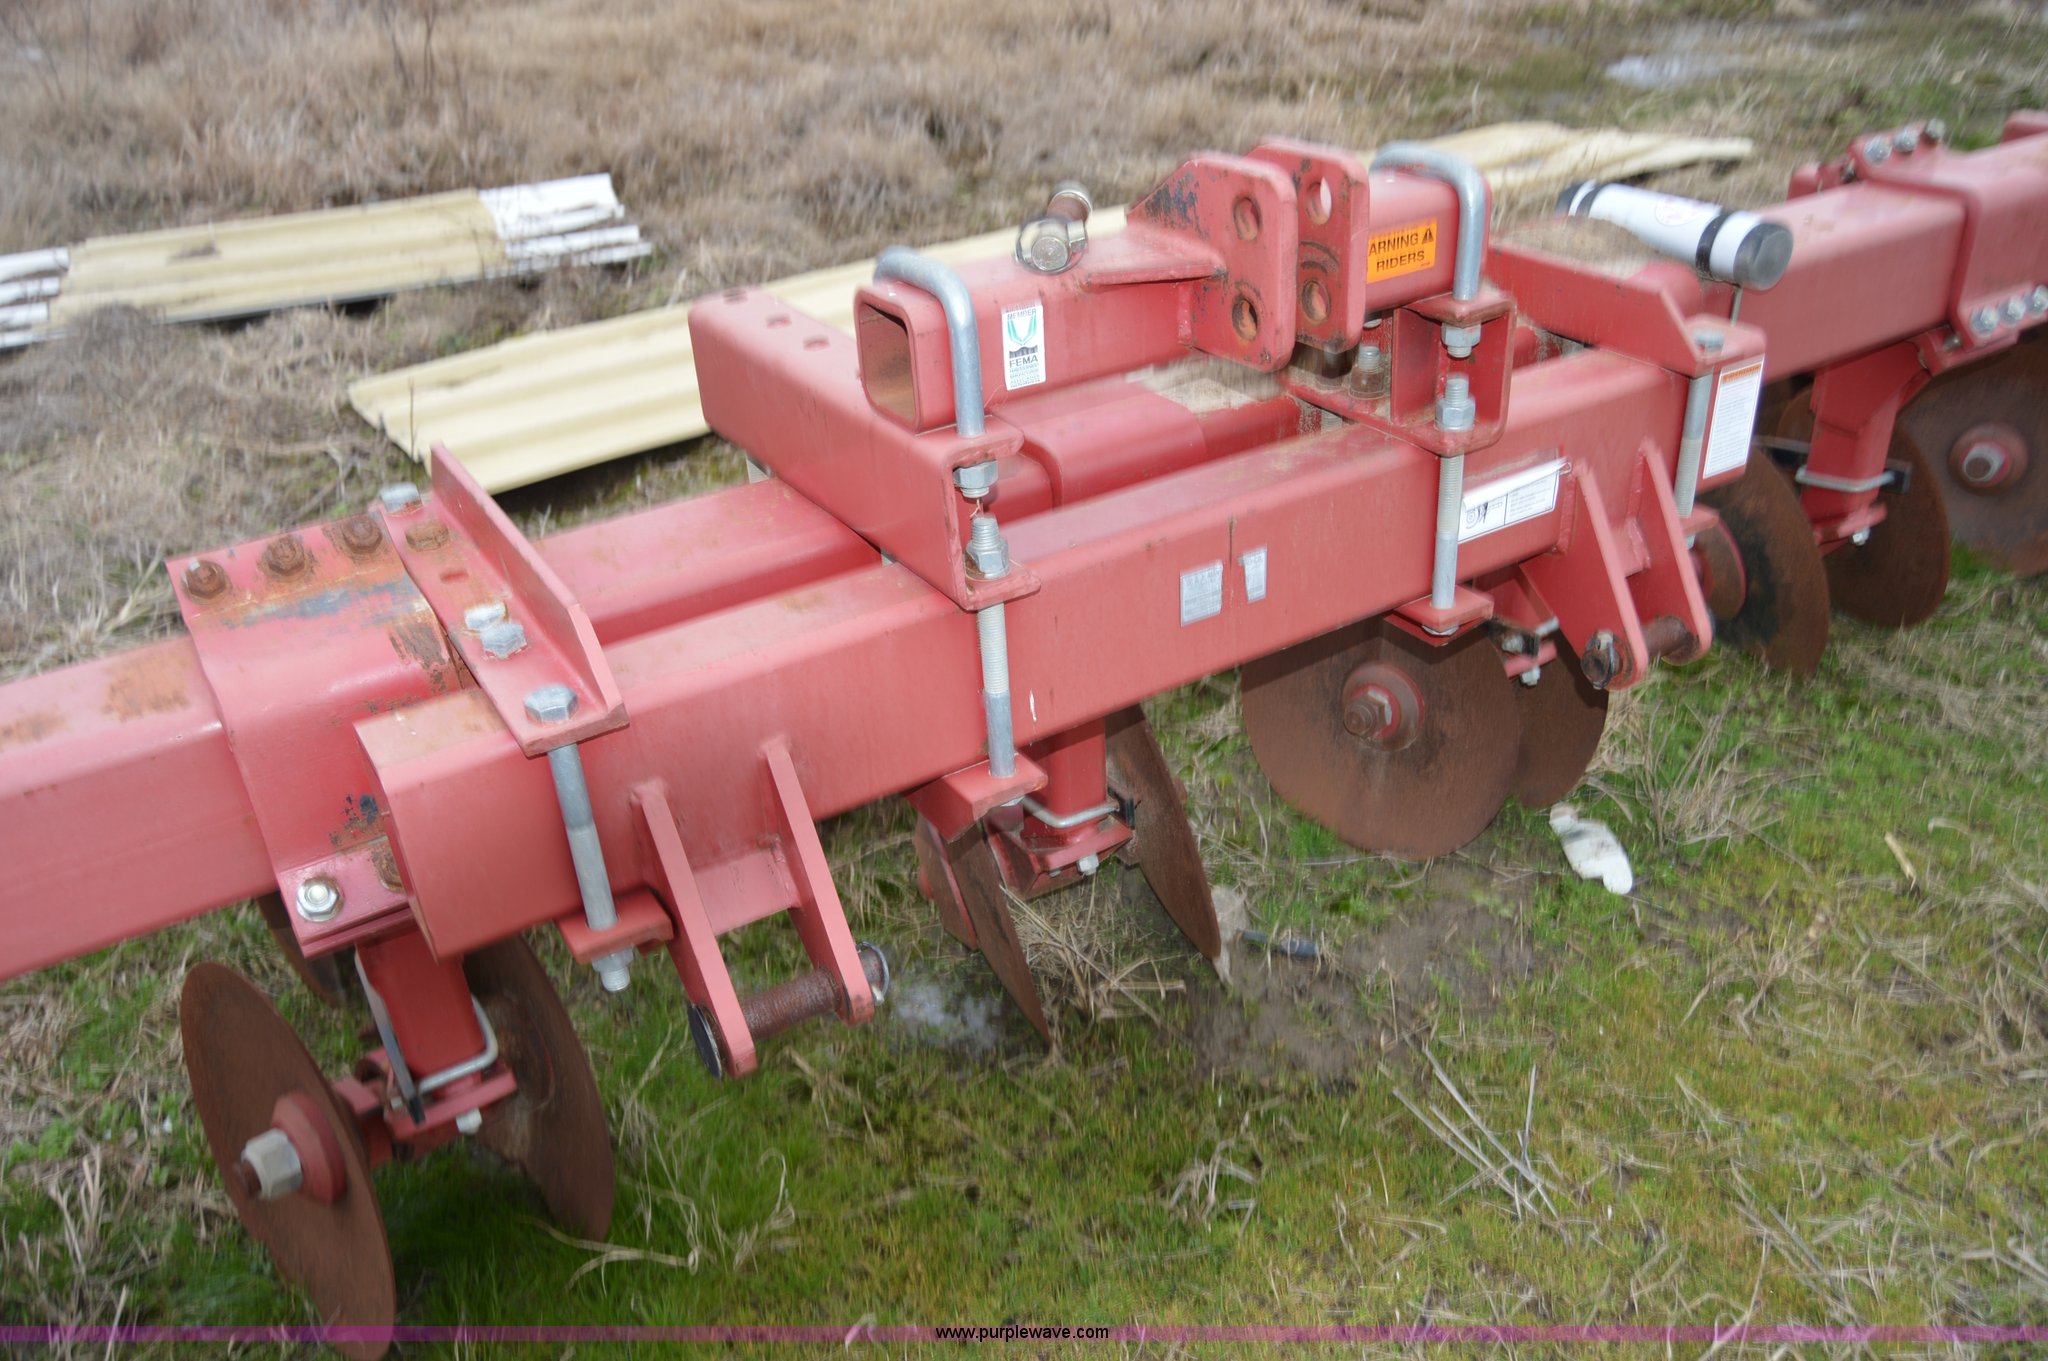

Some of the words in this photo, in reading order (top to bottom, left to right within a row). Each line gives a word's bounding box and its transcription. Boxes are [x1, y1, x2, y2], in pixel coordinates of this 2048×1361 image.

[1368, 232, 1419, 257] ARNING
[1376, 250, 1425, 272] RIDERS
[1009, 355, 1039, 368] FEMA
